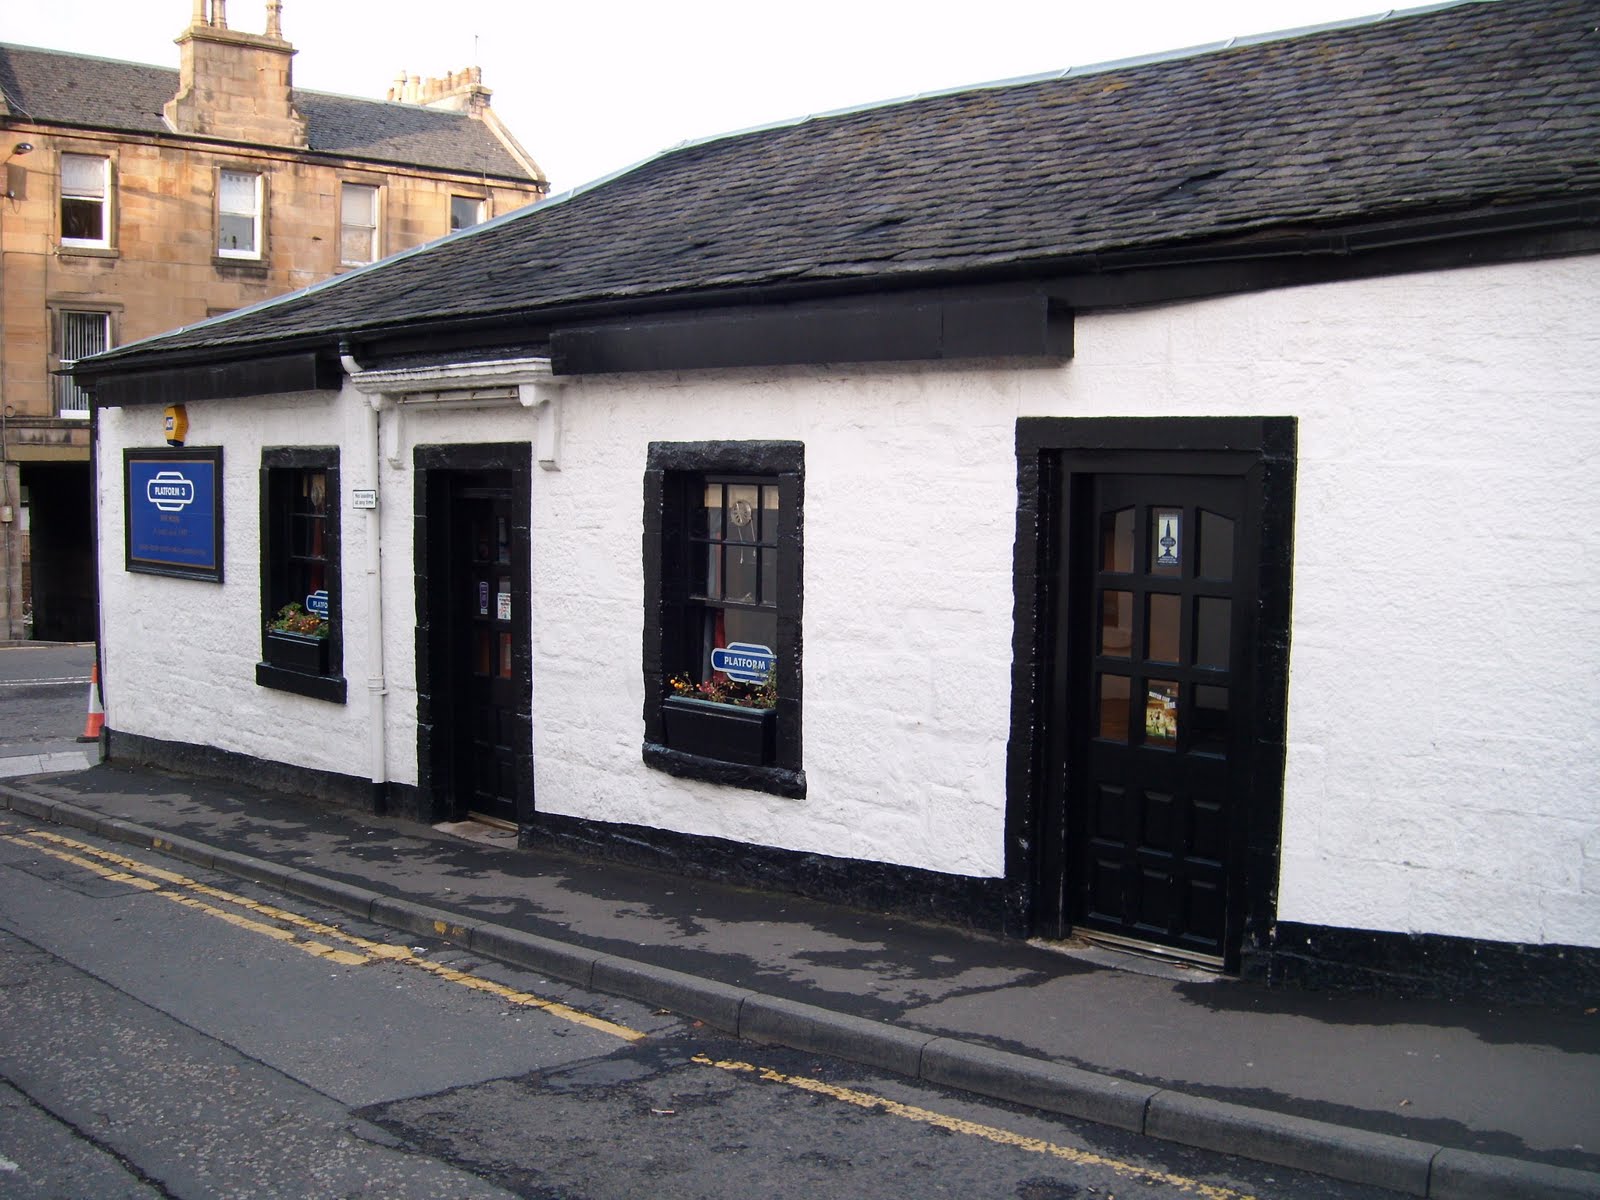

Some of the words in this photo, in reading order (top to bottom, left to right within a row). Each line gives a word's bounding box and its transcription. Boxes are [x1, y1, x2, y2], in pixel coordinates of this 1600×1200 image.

[154, 486, 179, 496] PLATFORM
[181, 487, 186, 496] 3
[724, 656, 766, 670] PLATFORM
